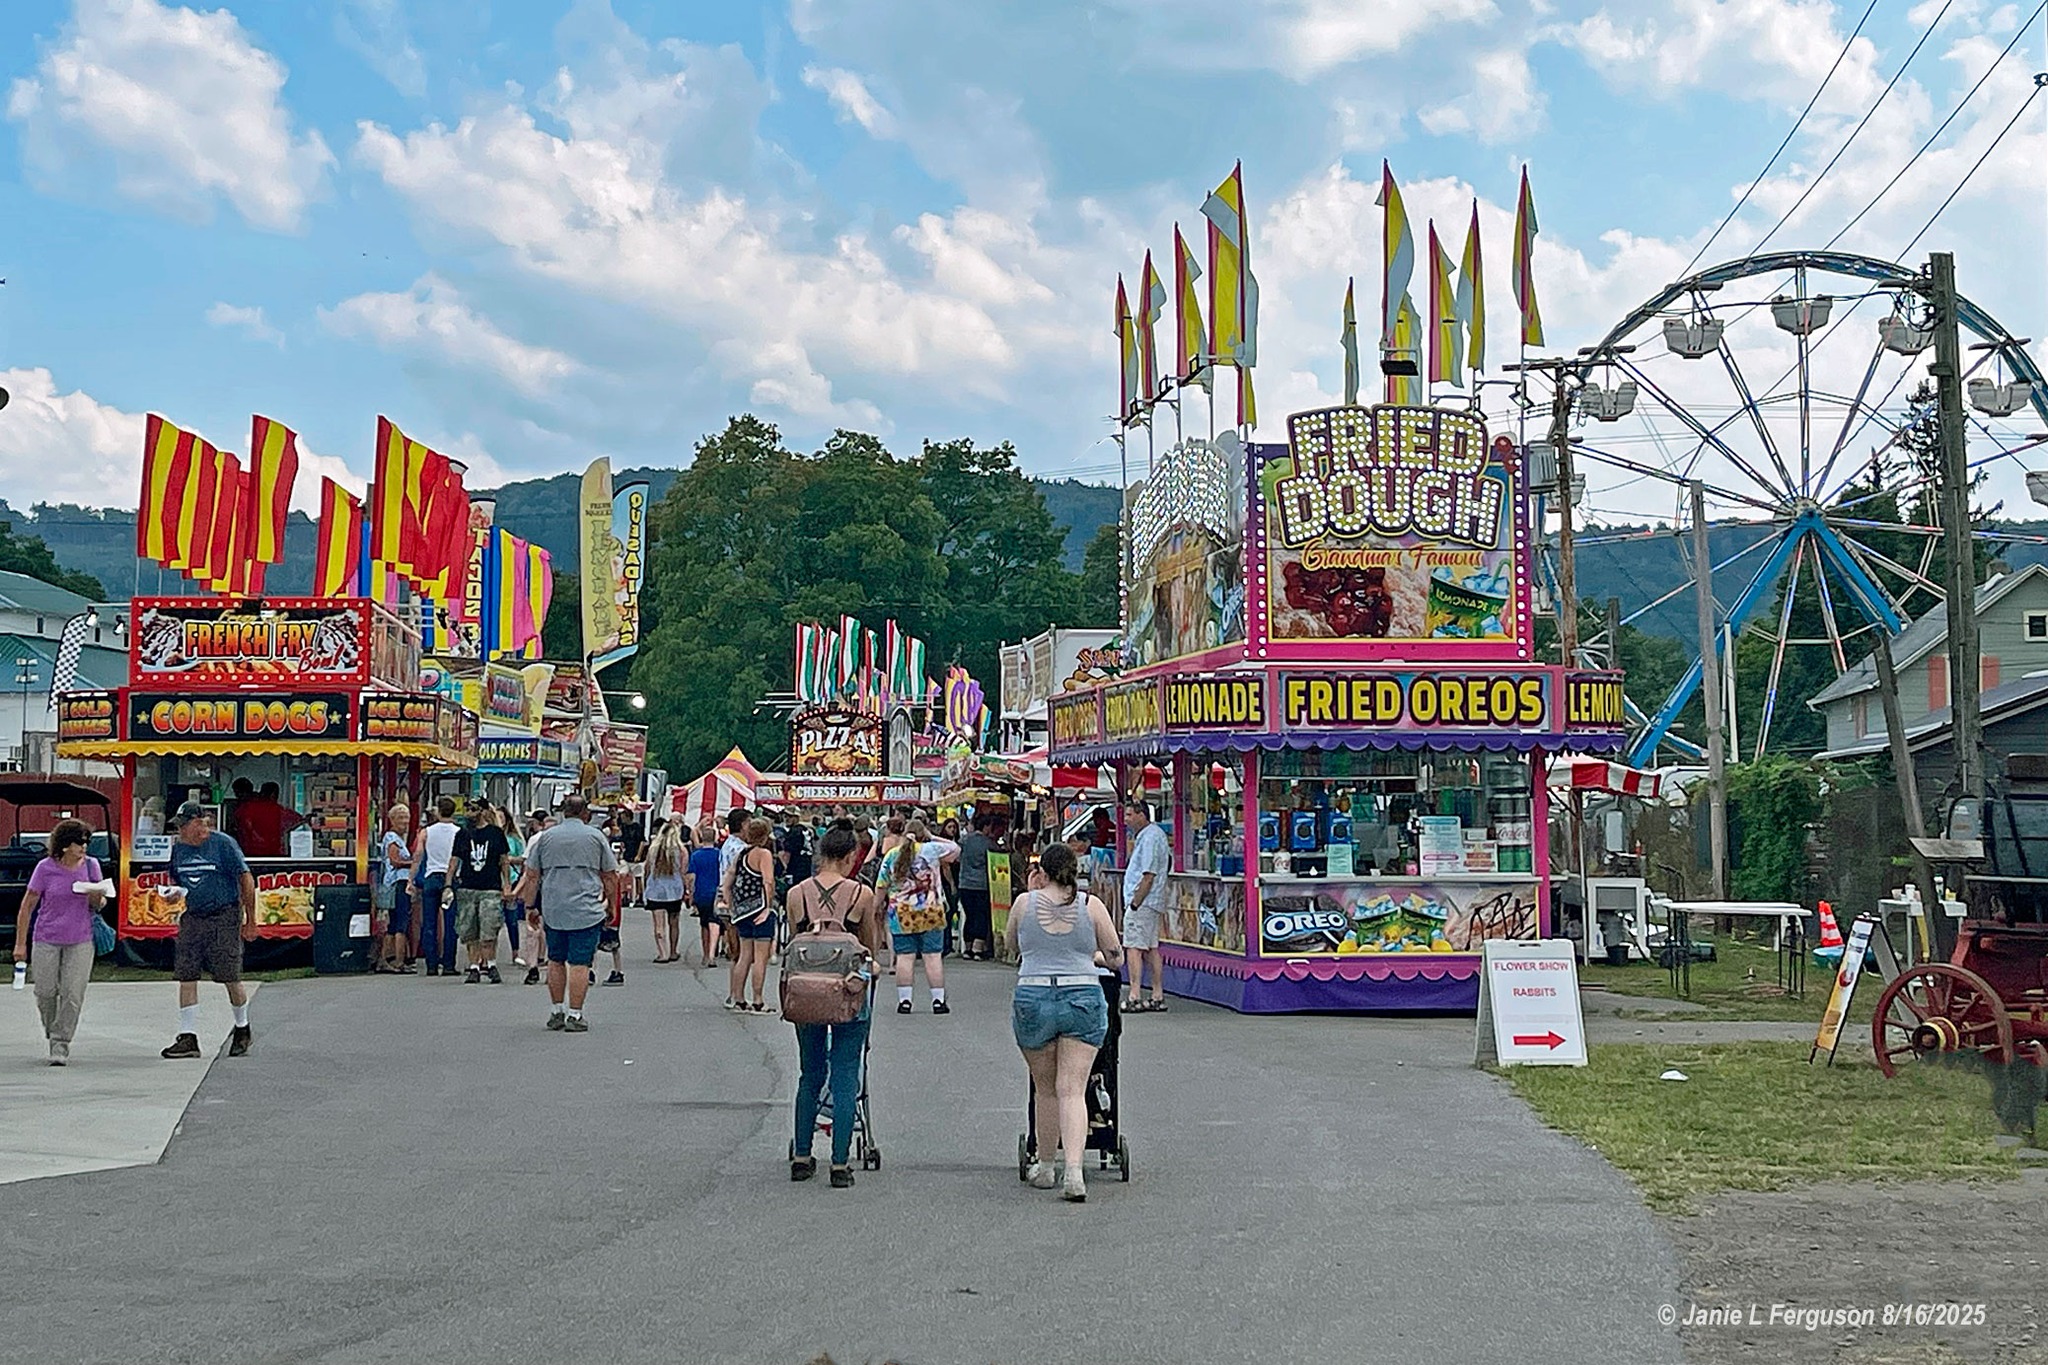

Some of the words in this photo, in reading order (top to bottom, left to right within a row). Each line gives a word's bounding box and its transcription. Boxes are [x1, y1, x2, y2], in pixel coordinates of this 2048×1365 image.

[1292, 408, 1485, 478] FRIED
[1280, 468, 1500, 544] DOUGH
[1409, 541, 1483, 571] Famous
[185, 622, 270, 658] FRENCH
[275, 622, 318, 658] FRY
[299, 644, 345, 673] Bowl
[70, 700, 113, 718] COLD
[368, 701, 401, 718] ICE
[1165, 681, 1261, 722] LEMONADE
[1289, 681, 1400, 721] FRIED
[1412, 681, 1544, 722] OREOS
[1569, 682, 1623, 722] LEMON
[152, 701, 237, 733] CORN
[244, 701, 329, 733] DOGS
[479, 742, 497, 760] OLD
[499, 742, 531, 760] DRINKS
[800, 726, 877, 756] PIZZA!
[796, 784, 836, 798] CHEESE
[839, 784, 870, 798] PIZZA
[1266, 913, 1345, 936] OREO
[1494, 962, 1537, 971] FLOWER
[1539, 962, 1569, 971] SHOW
[1513, 988, 1557, 996] RABBITS
